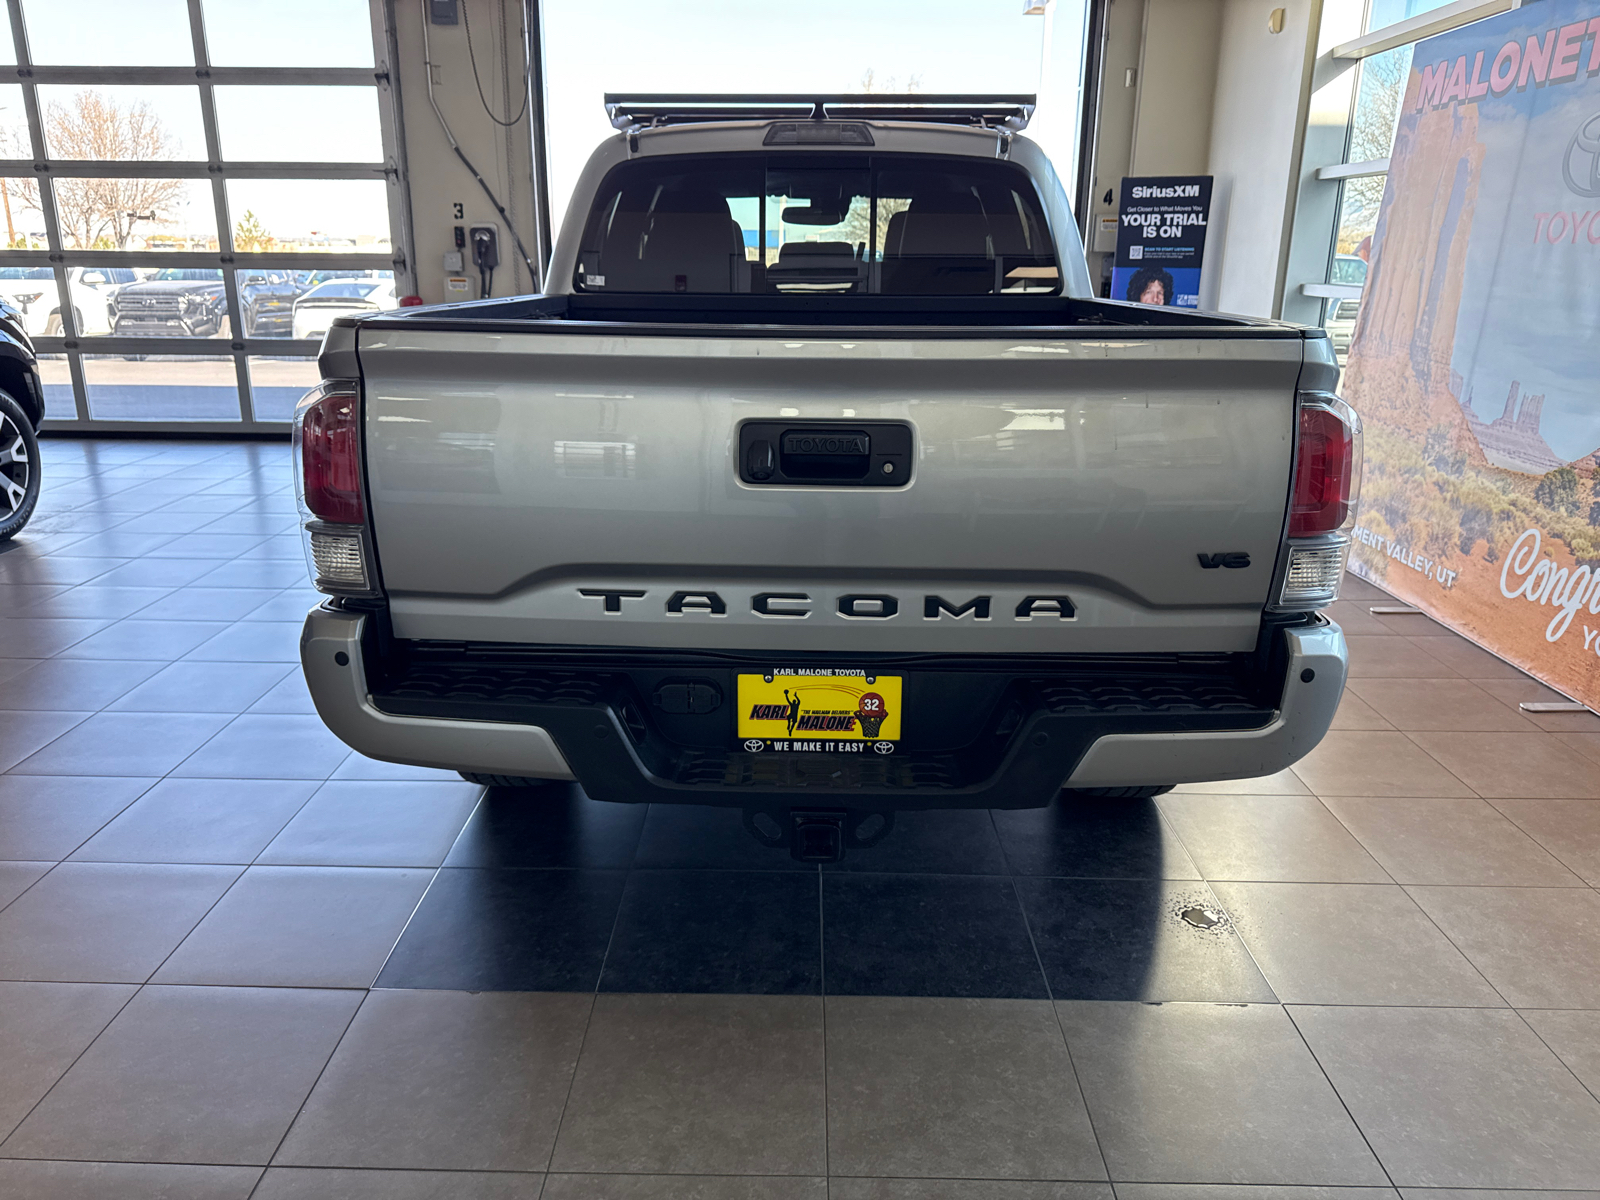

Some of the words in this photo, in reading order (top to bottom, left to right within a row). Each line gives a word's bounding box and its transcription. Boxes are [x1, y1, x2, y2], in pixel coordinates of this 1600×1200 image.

[1103, 188, 1113, 206] 4
[1132, 185, 1200, 198] SiriusXM
[453, 202, 464, 219] 3
[1121, 214, 1161, 226] YOUR
[1164, 213, 1207, 225] TRIAL
[1143, 226, 1157, 238] IS
[1160, 226, 1182, 238] ON
[789, 438, 863, 453] TOYOTA
[1197, 551, 1251, 569] V6
[1351, 525, 1384, 551] MENT
[1386, 540, 1433, 580] VALLEY,
[1436, 565, 1456, 588] UT
[576, 588, 1078, 622] TACOMA
[1583, 625, 1600, 657] Y
[773, 668, 796, 676] KARL
[798, 668, 832, 676] MALONE
[834, 669, 866, 677] TOYOTA
[749, 704, 789, 720] KARL
[864, 698, 880, 711] 32
[796, 715, 856, 731] MALONE
[774, 742, 789, 751] WE
[793, 742, 822, 752] MAKE
[826, 743, 835, 752] IT
[838, 743, 864, 752] EASY
